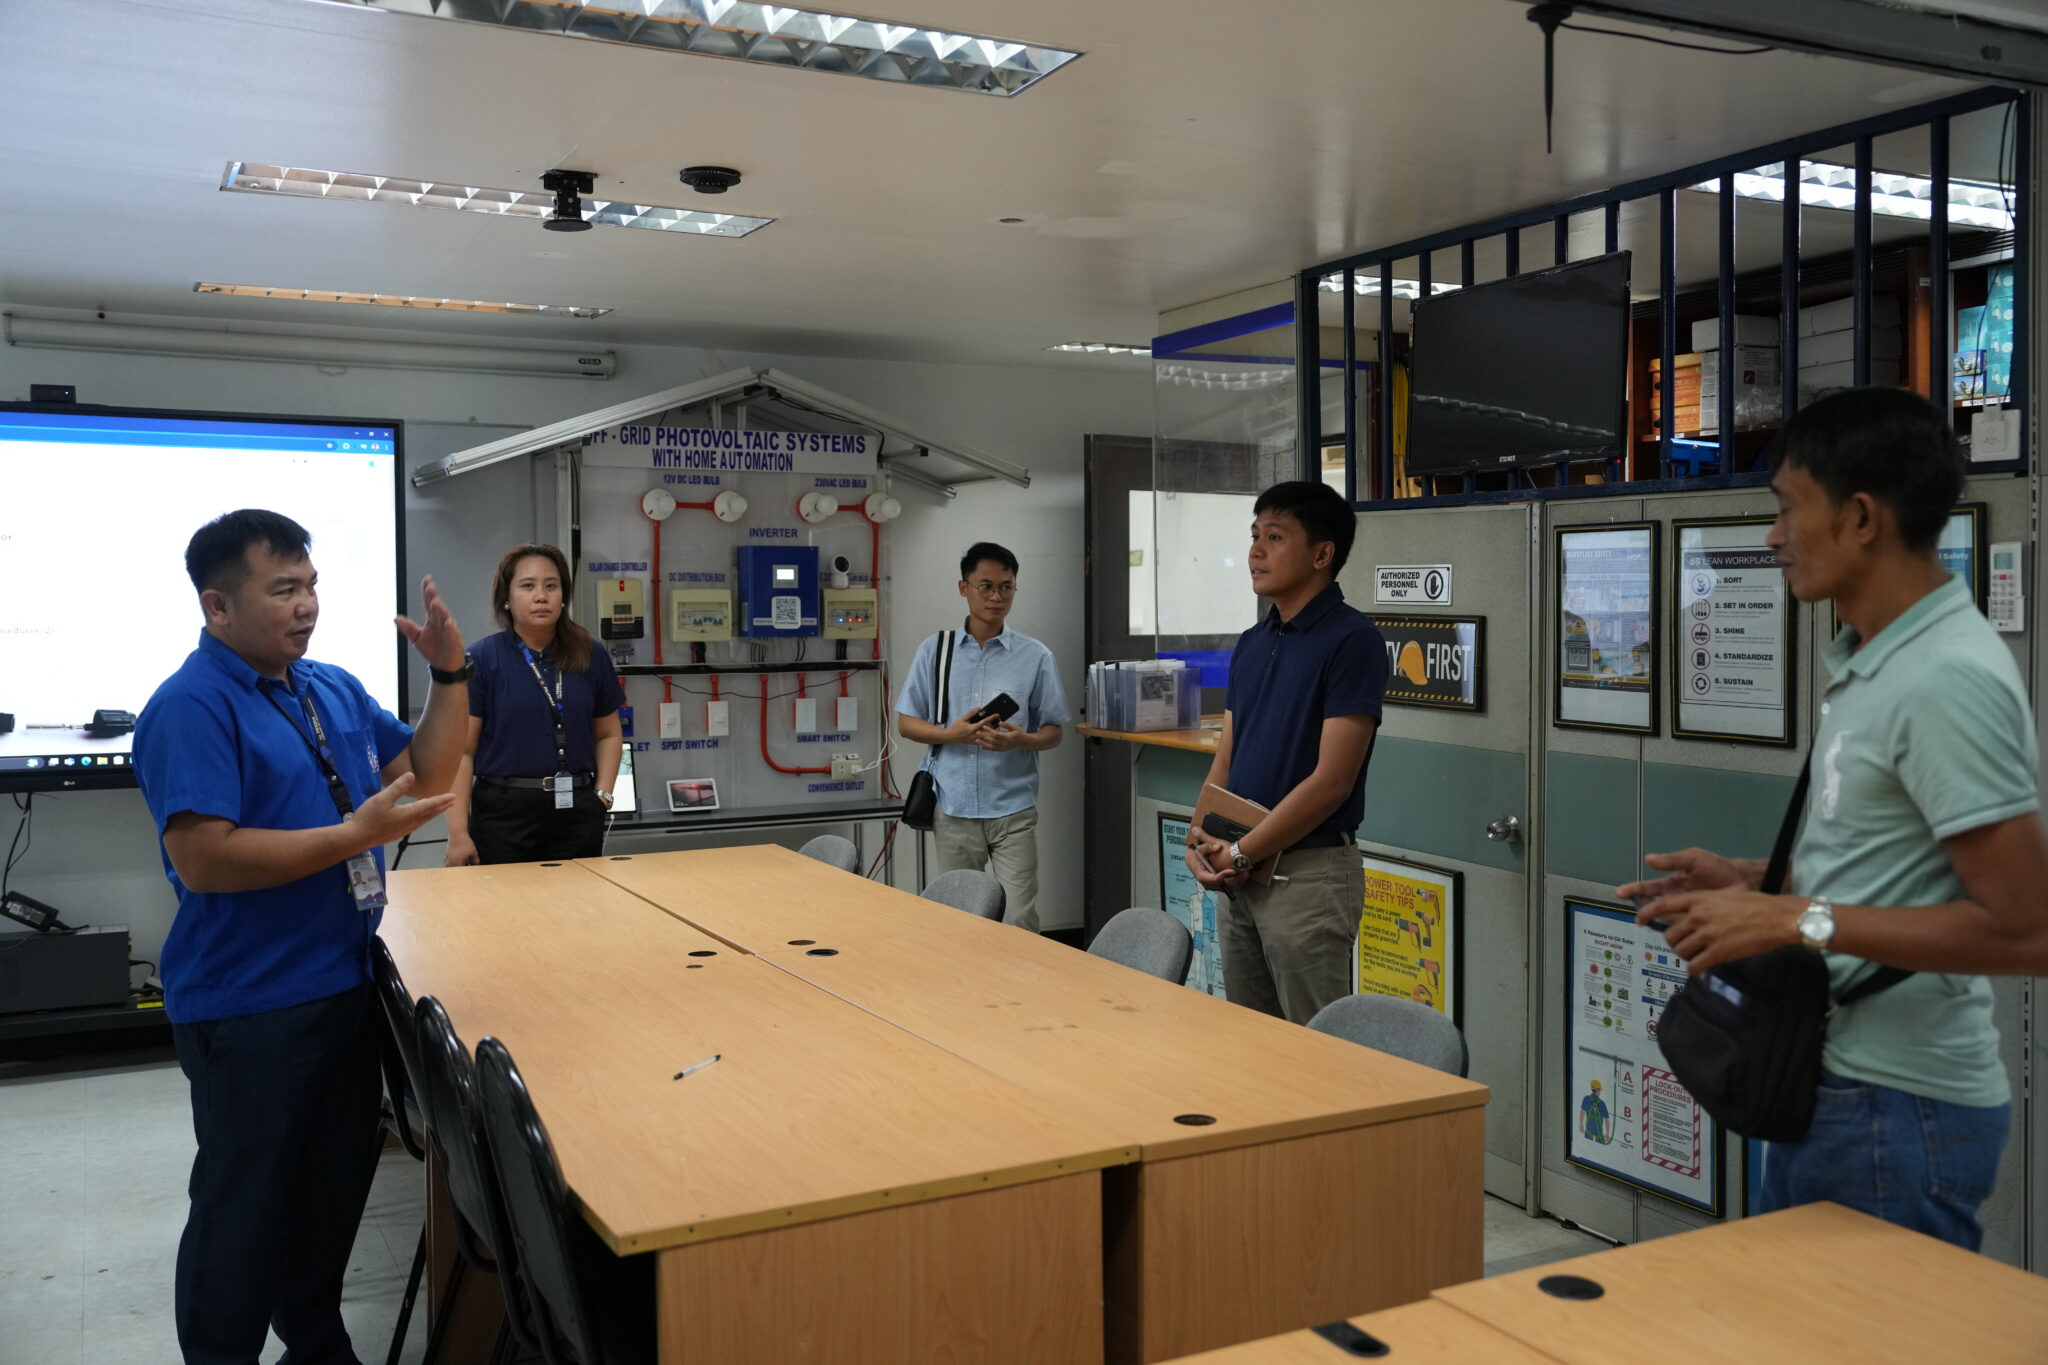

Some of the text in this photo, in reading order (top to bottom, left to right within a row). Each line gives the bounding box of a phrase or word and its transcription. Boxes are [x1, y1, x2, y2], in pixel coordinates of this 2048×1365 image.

[620, 426, 651, 446] GRID
[655, 427, 780, 451] PHOTOVOLTAIC
[786, 434, 866, 454] SYSTEMS
[653, 448, 793, 472] WITH HOME AUTOMATION
[663, 474, 720, 486] 12V DC LED BULB
[839, 478, 851, 488] LED
[852, 479, 867, 489] BULB
[749, 527, 799, 538] INVERTER
[1703, 557, 1723, 566] LEAN
[1725, 555, 1777, 565] WORKPLACE
[1943, 552, 1969, 561] Safety
[1381, 572, 1420, 580] AUTHORIZED
[1381, 580, 1418, 588] PERSONNEL
[1391, 589, 1408, 597] ONLY
[1426, 642, 1472, 682] FIRST
[1723, 653, 1774, 661] STANDARDIZE
[1723, 678, 1754, 686] SUSTAIN
[797, 734, 851, 743] SMART SWITCH
[632, 742, 651, 752] LET
[662, 739, 719, 751] SPDT SWITCH
[808, 781, 865, 793] CONVENIENCE OUTLET
[1166, 835, 1187, 846] PERSONA
[1364, 876, 1417, 898] POWER TOOL
[1364, 887, 1415, 910] SAFETY TIPS
[1587, 930, 1608, 939] Reasons
[1594, 939, 1609, 948] RIGHT
[1645, 943, 1654, 951] Stay
[1623, 1071, 1632, 1083] A
[1656, 1080, 1687, 1095] LOCK-OUT
[1650, 1086, 1691, 1104] PROCEDURES
[1624, 1106, 1632, 1118] B
[1623, 1132, 1632, 1143] C
